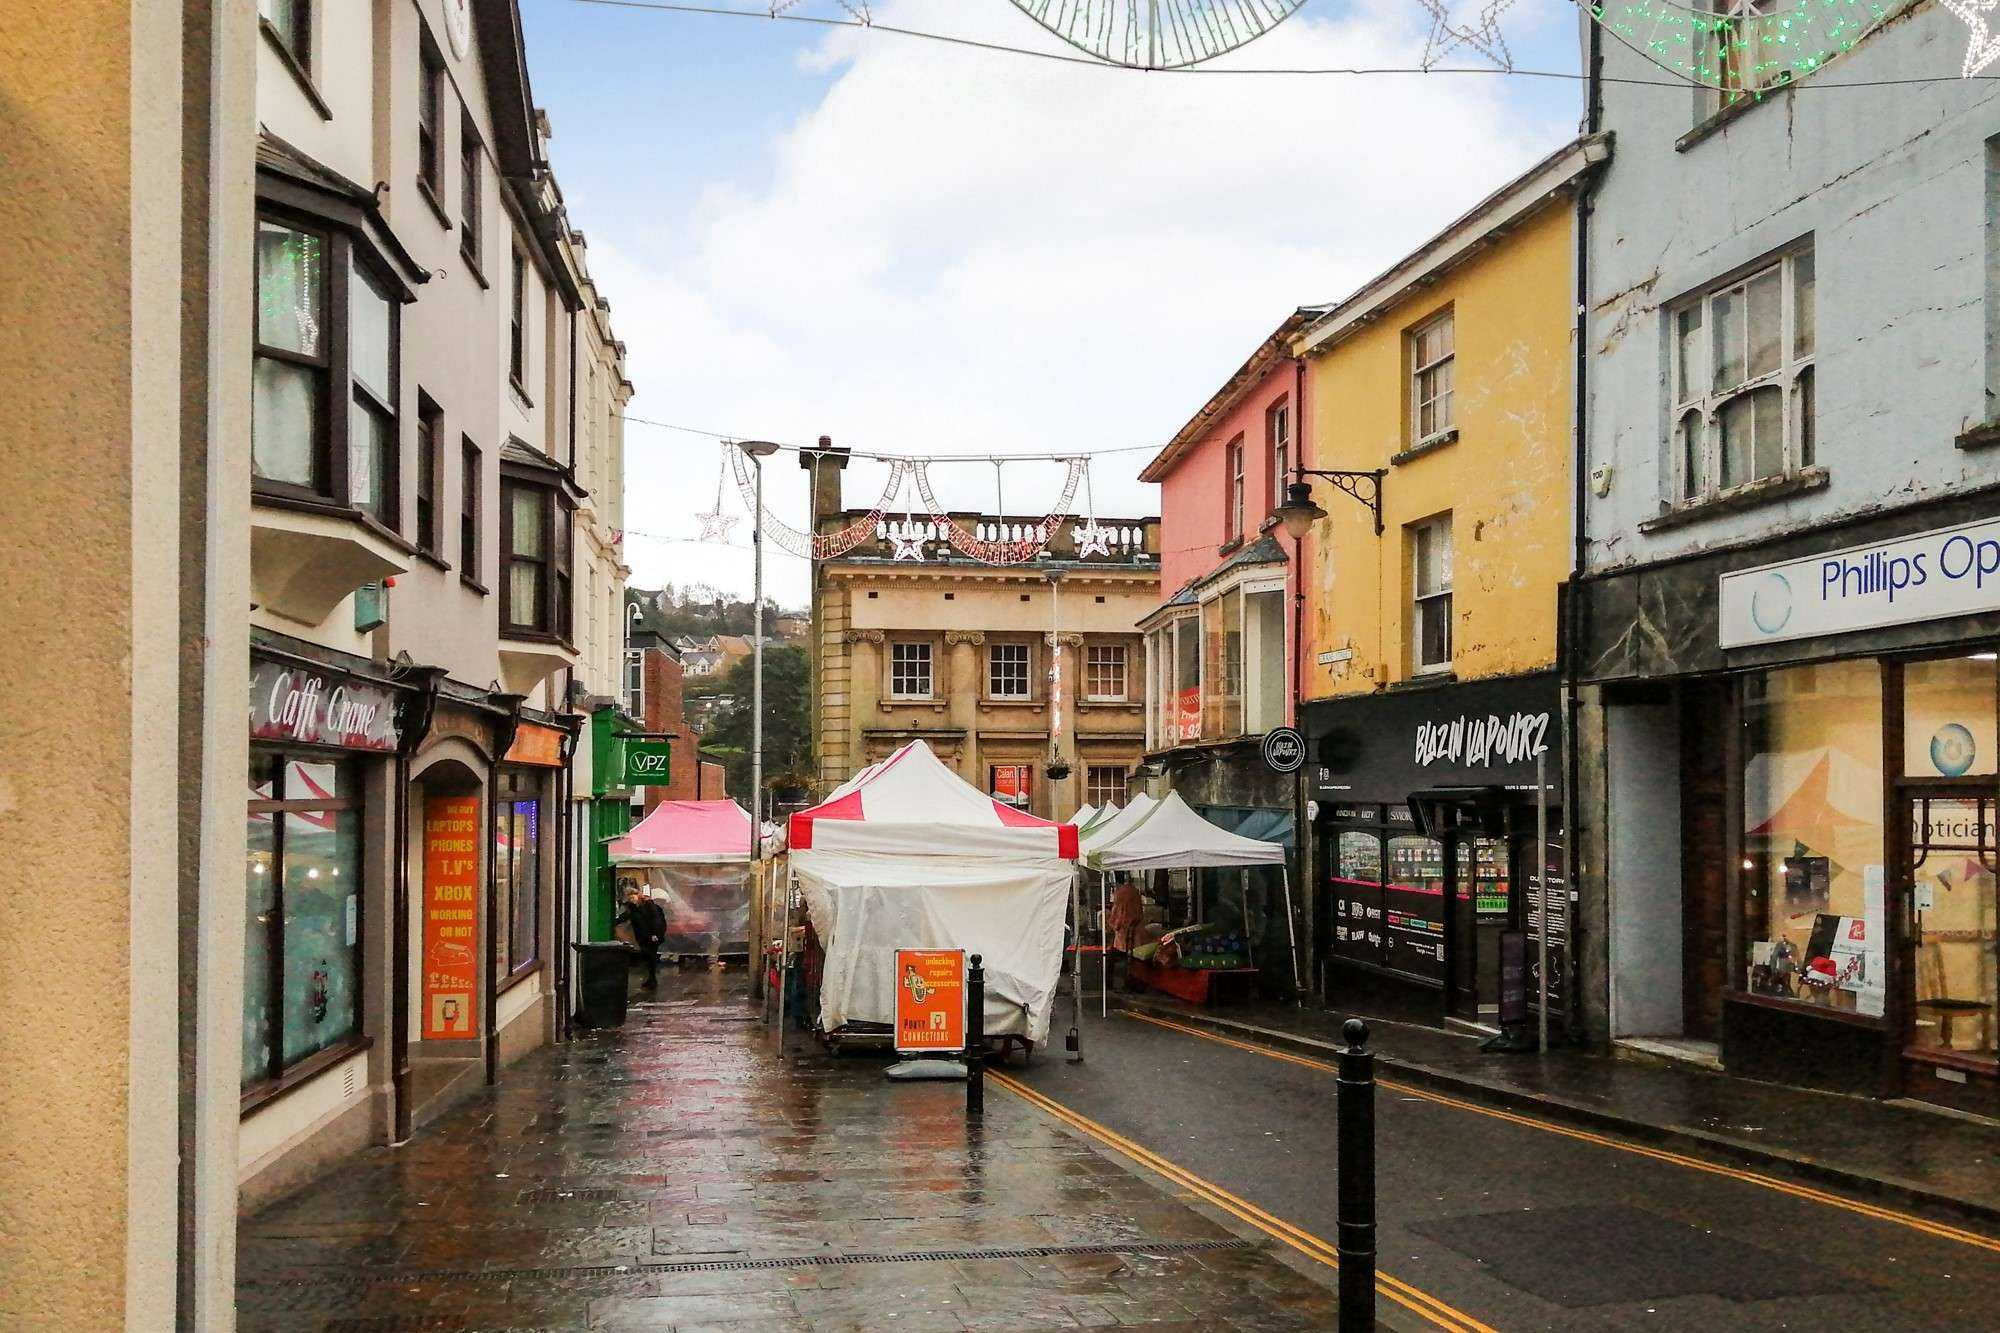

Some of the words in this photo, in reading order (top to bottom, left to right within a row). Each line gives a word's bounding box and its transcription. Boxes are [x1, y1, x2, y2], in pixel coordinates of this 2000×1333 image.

[1822, 551, 1928, 602] Phillips
[1414, 714, 1465, 767] BLAZIN
[1465, 711, 1550, 769] VAPOURZ
[634, 755, 666, 771] VPZ
[427, 820, 474, 833] LAPTOPS
[431, 839, 474, 852] PHONES
[434, 885, 473, 901] XBOX
[430, 908, 473, 920] WORKING
[440, 926, 453, 938] OR
[455, 926, 473, 938] NOT
[903, 1030, 949, 1042] CONNECTIONS
